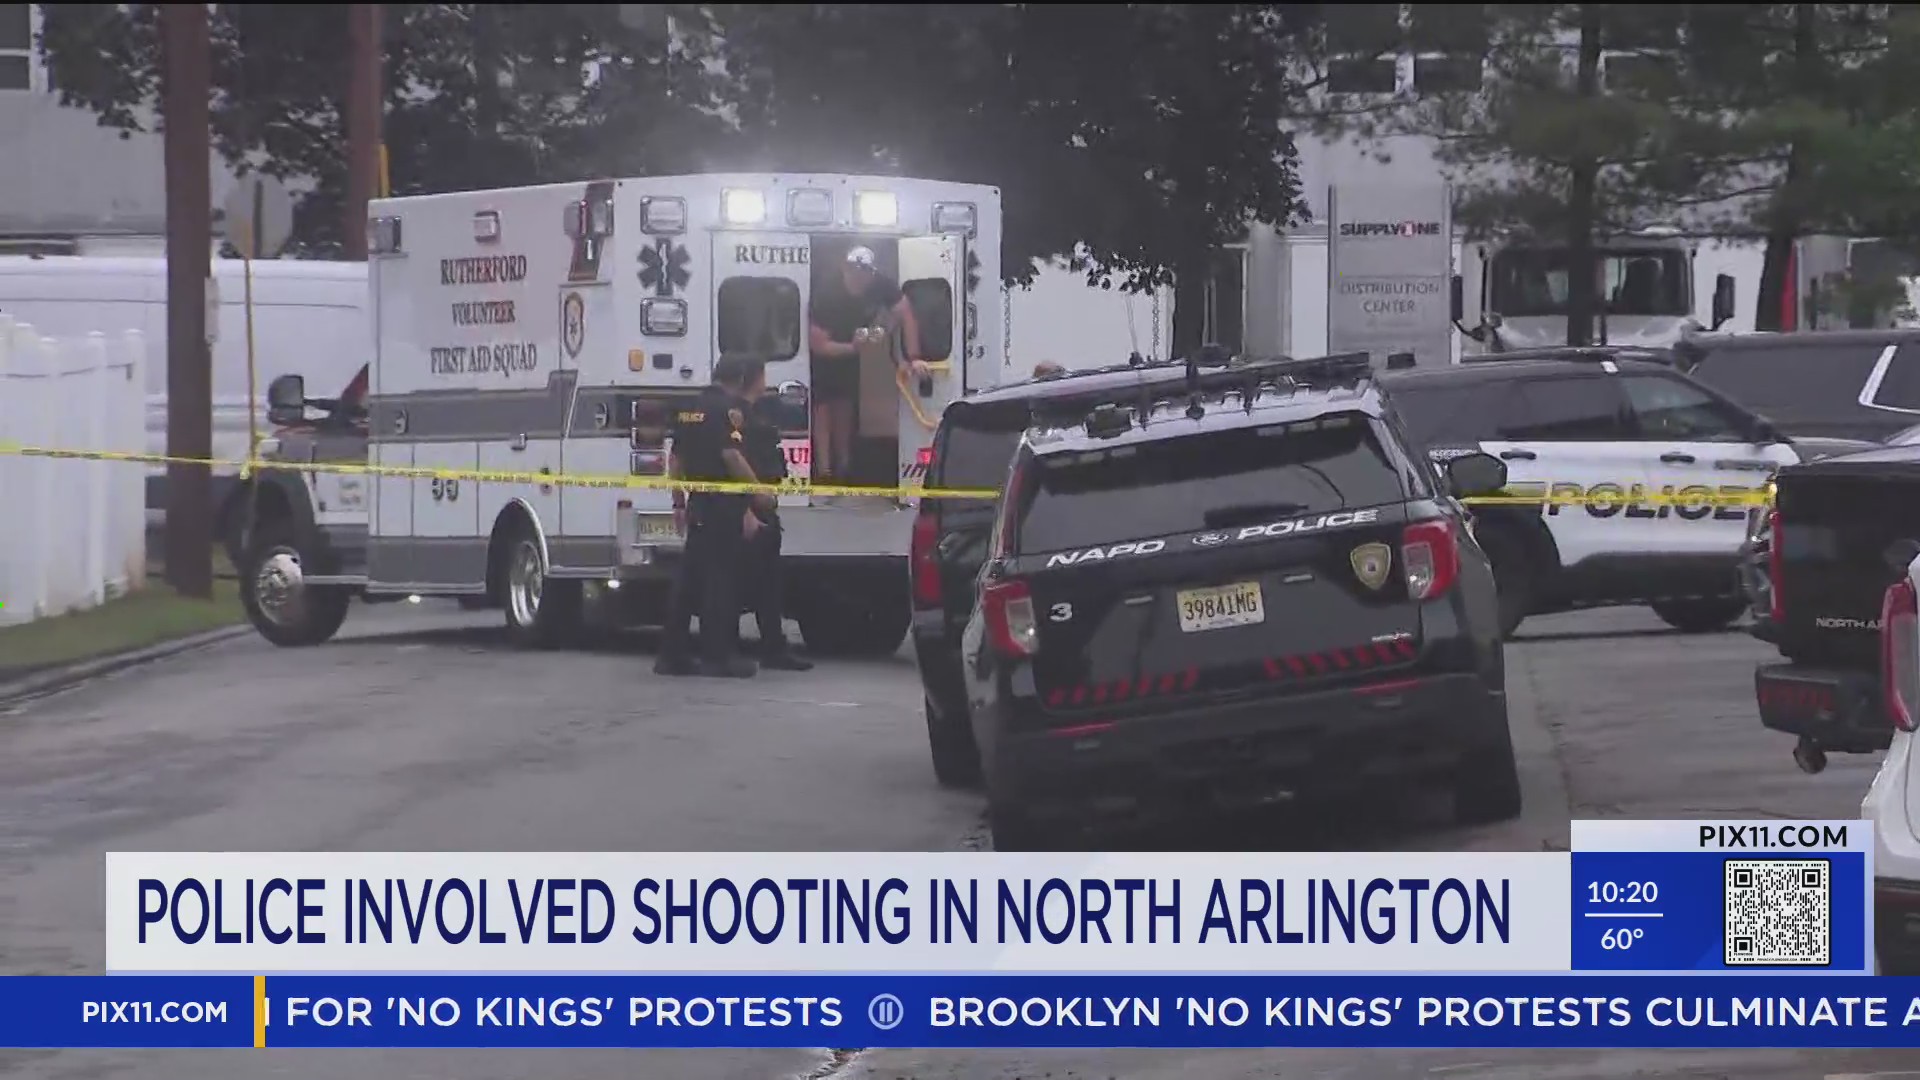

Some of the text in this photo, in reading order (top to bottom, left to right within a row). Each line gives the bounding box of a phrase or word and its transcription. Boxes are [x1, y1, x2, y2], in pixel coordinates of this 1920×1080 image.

[440, 254, 527, 286] RUTHERFORD
[1340, 282, 1440, 295] DISTRIBUTION
[451, 300, 516, 326] VOLUNTEER
[1362, 300, 1416, 313] CENTER
[430, 341, 537, 378] FIRST AID SQUAD
[1547, 482, 1751, 521] POLICE
[1236, 508, 1379, 541] POLICE
[1050, 602, 1074, 623] 3
[1815, 617, 1866, 629] NORTH
